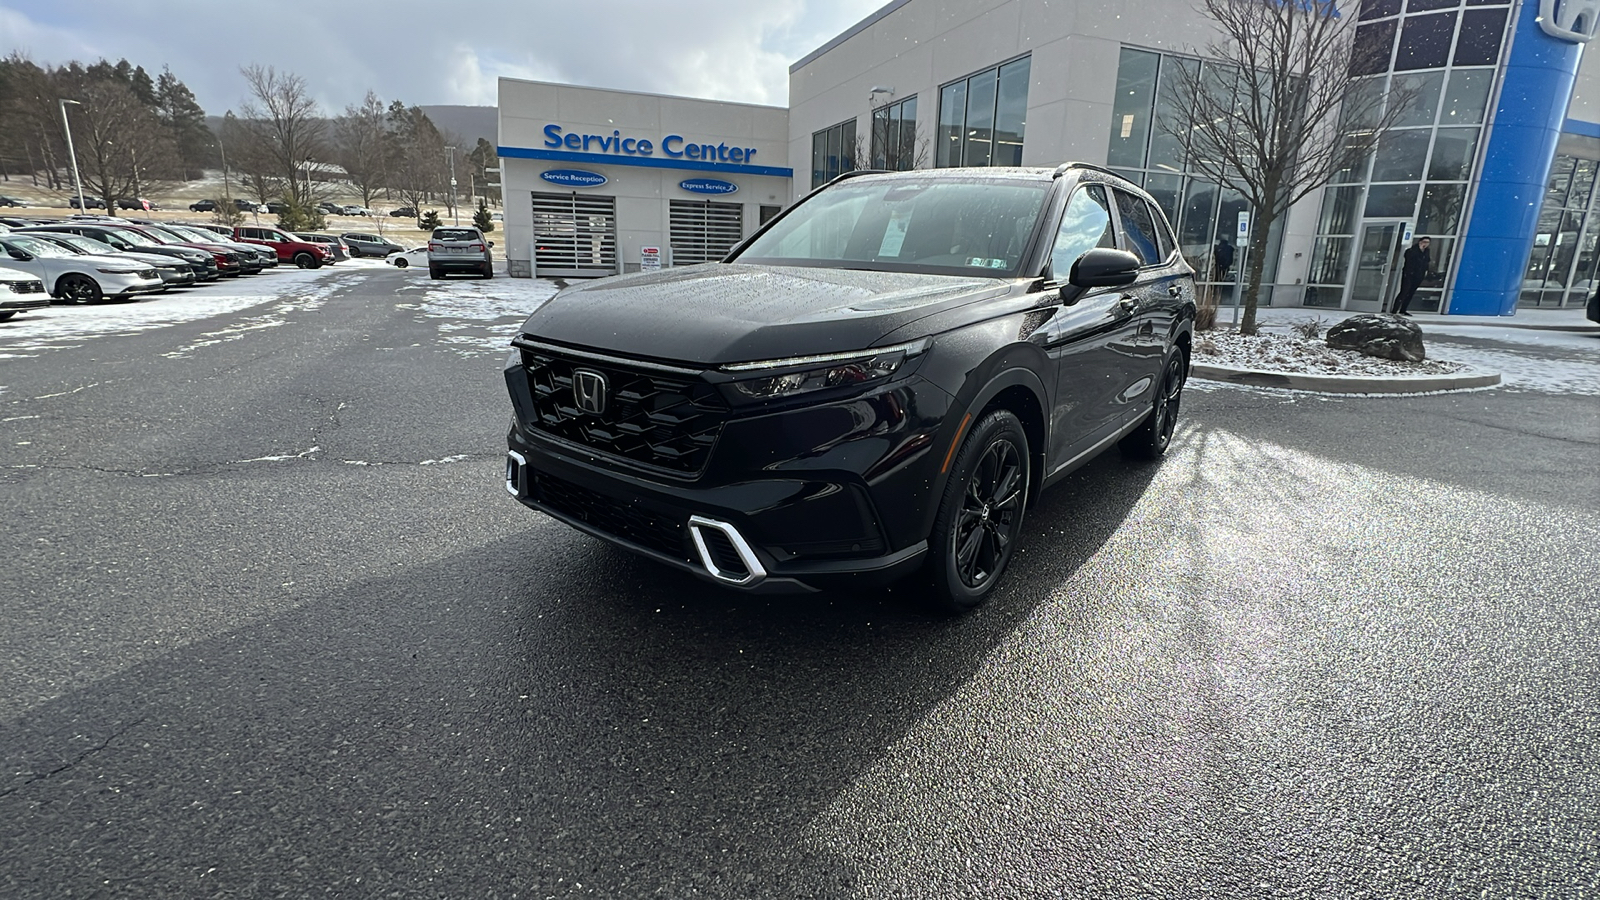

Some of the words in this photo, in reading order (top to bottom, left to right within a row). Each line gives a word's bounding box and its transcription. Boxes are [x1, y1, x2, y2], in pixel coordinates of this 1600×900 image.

[543, 124, 653, 156] Service
[662, 135, 757, 163] Center
[544, 172, 569, 181] Service
[570, 174, 604, 183] Reception
[682, 182, 704, 190] Express
[705, 183, 727, 191] Service
